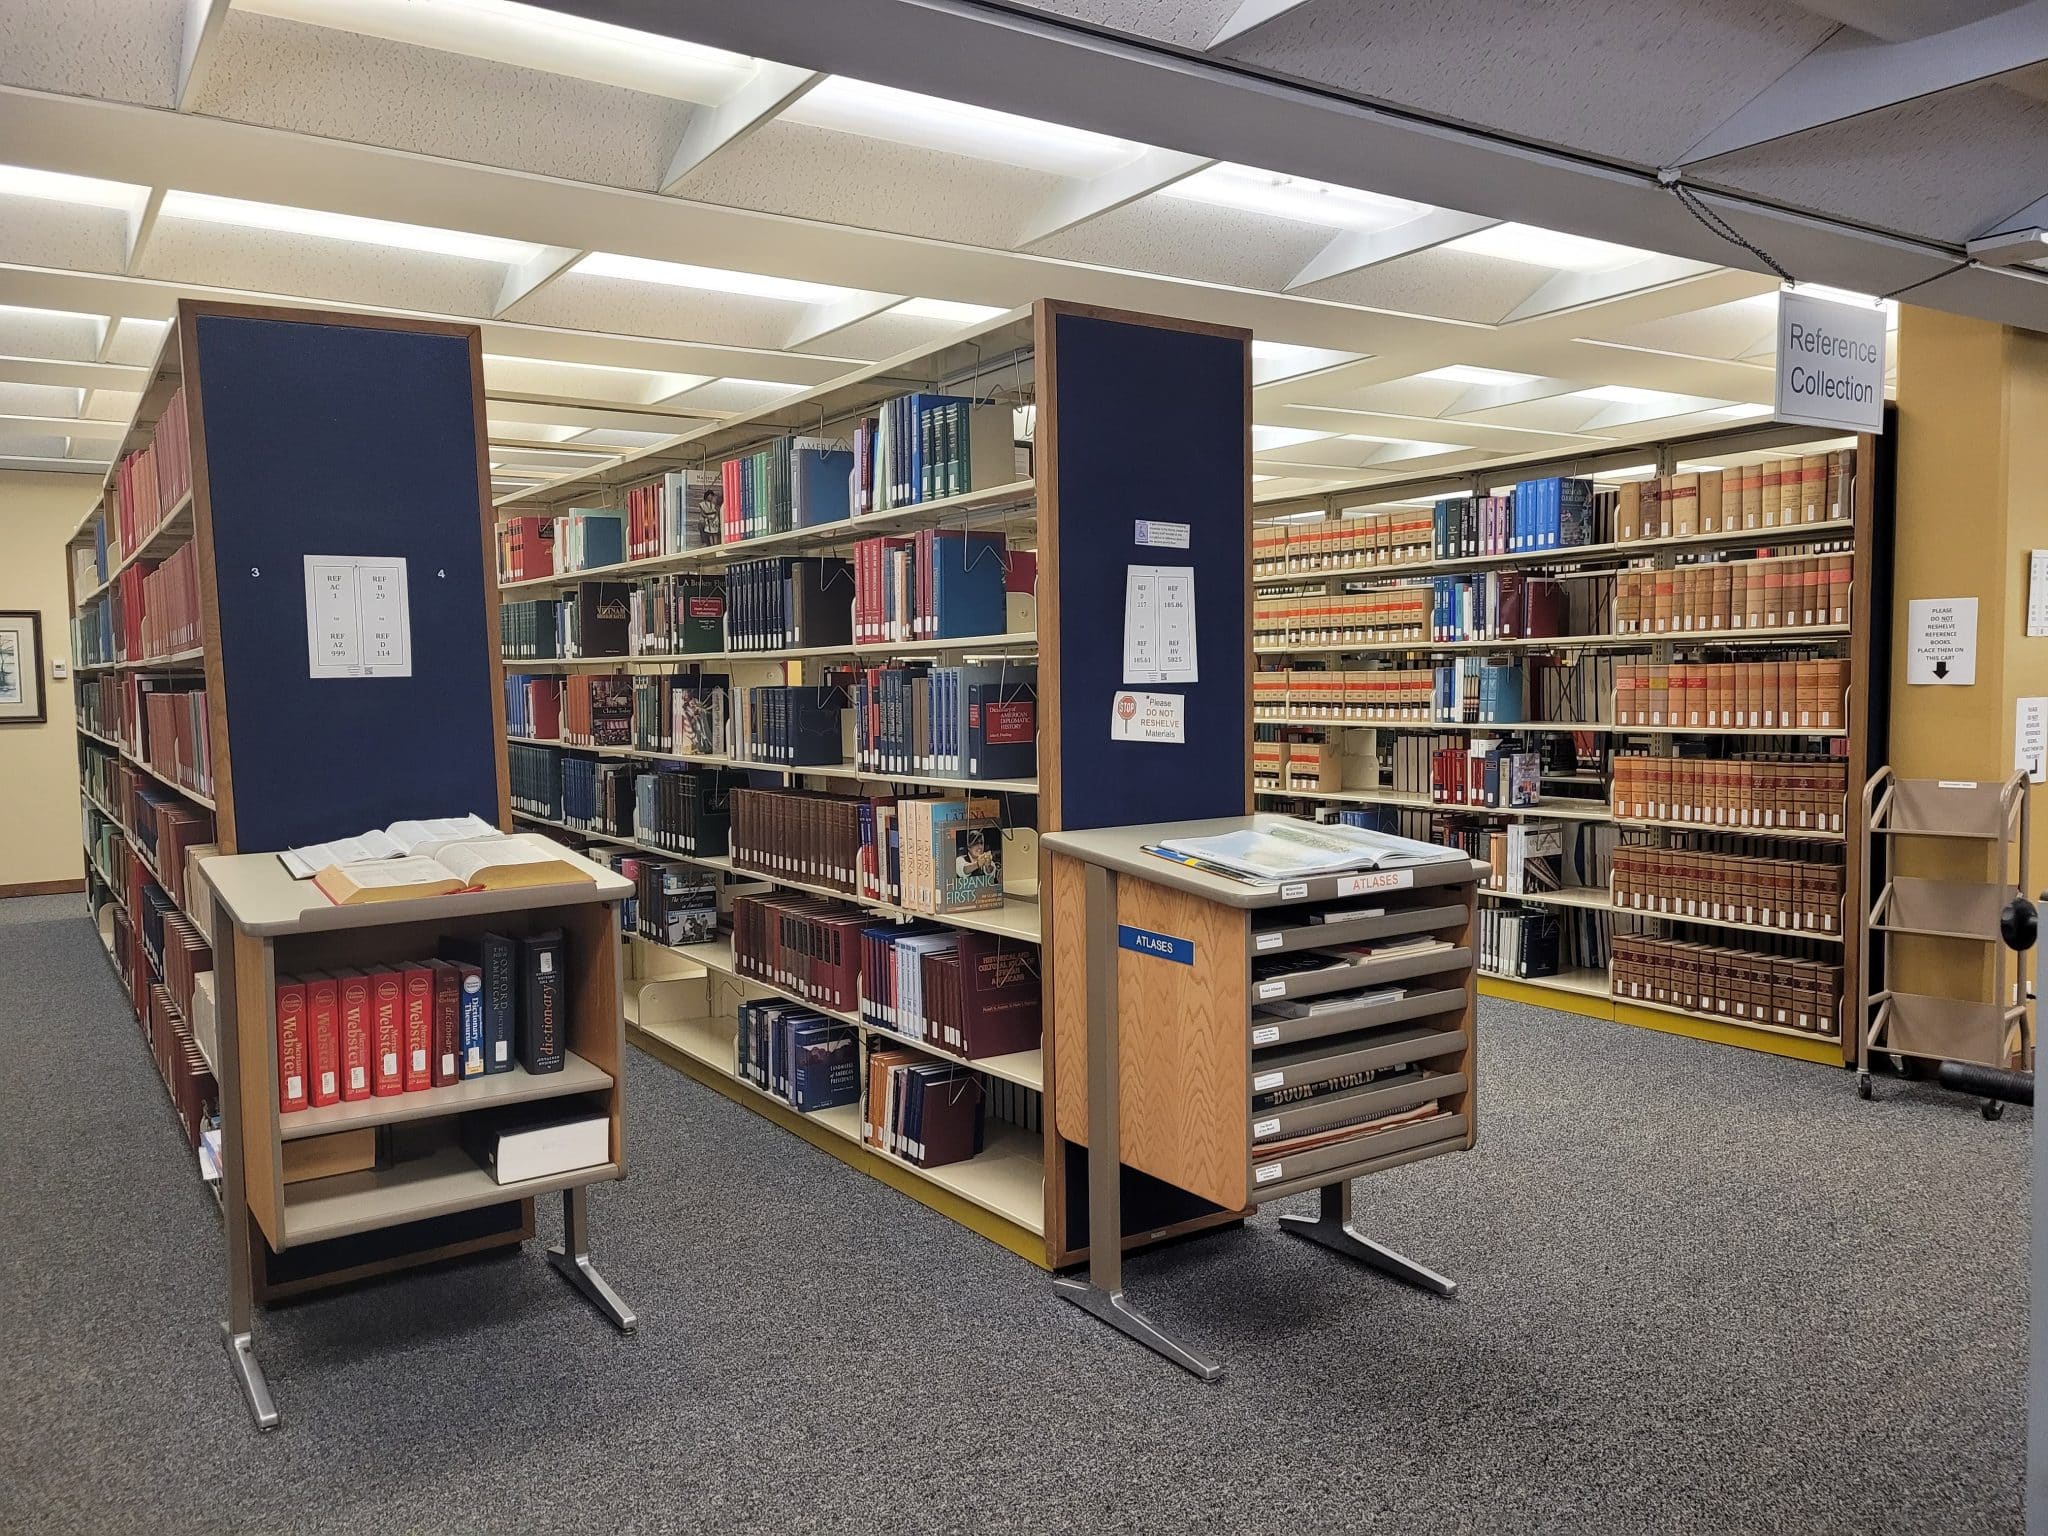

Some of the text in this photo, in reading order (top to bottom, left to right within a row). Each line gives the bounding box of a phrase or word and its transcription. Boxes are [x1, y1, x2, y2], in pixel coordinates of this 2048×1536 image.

[1790, 322, 1877, 364] Reference
[1790, 366, 1873, 404] Collection
[250, 568, 260, 577] 3
[438, 569, 446, 578] 4
[1120, 702, 1135, 713] STOP
[1149, 698, 1172, 707] Please
[1140, 719, 1180, 728] RESHELVE
[1146, 730, 1175, 738] Materials
[945, 876, 995, 891] HISPANIC
[1353, 873, 1398, 890] ATLASES
[946, 890, 976, 904] FIRSTS
[1136, 935, 1173, 954] ATLASES
[1274, 1085, 1313, 1105] BOOK
[1328, 1071, 1375, 1091] WORLD
